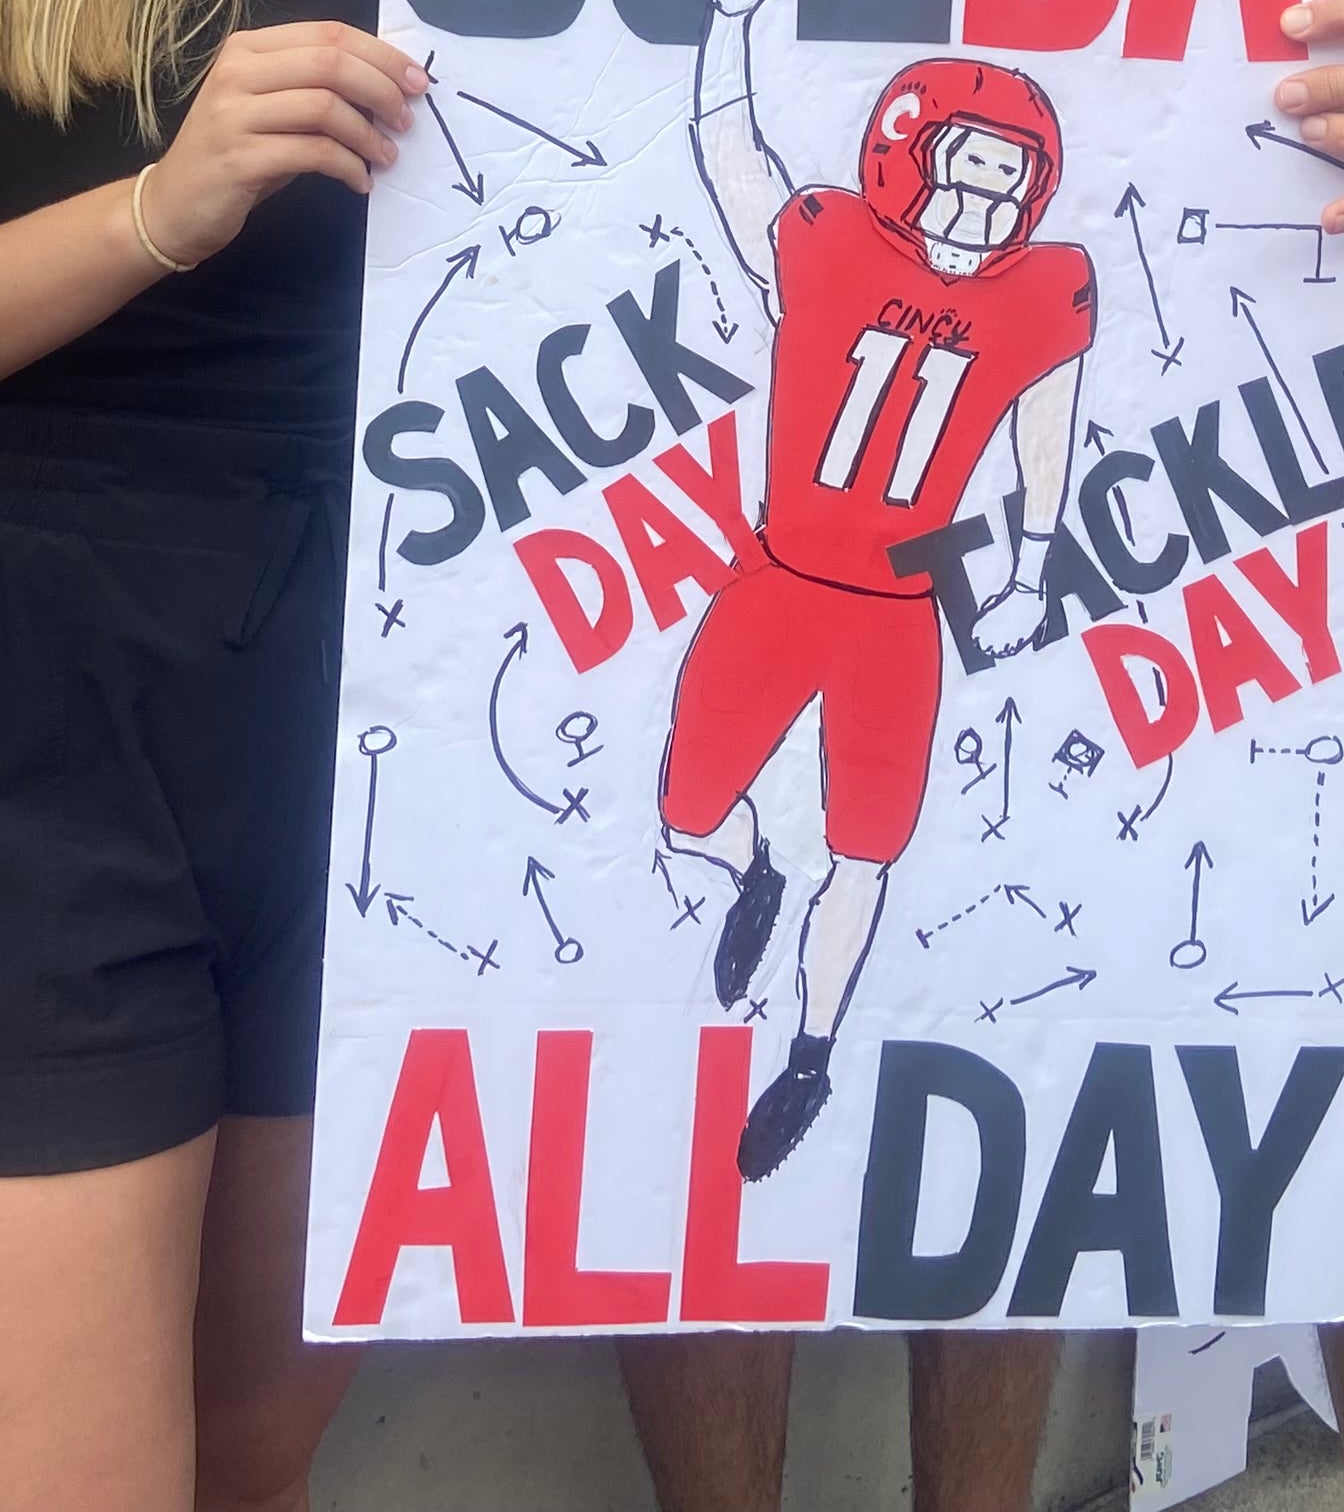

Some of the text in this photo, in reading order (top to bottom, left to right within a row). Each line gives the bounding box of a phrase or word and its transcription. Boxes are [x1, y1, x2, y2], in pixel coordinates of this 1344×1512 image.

[362, 259, 757, 566] SACK
[513, 410, 782, 675] DAY
[812, 325, 979, 509] 11
[1081, 521, 1342, 770] DAY
[332, 1025, 831, 1327] ALL
